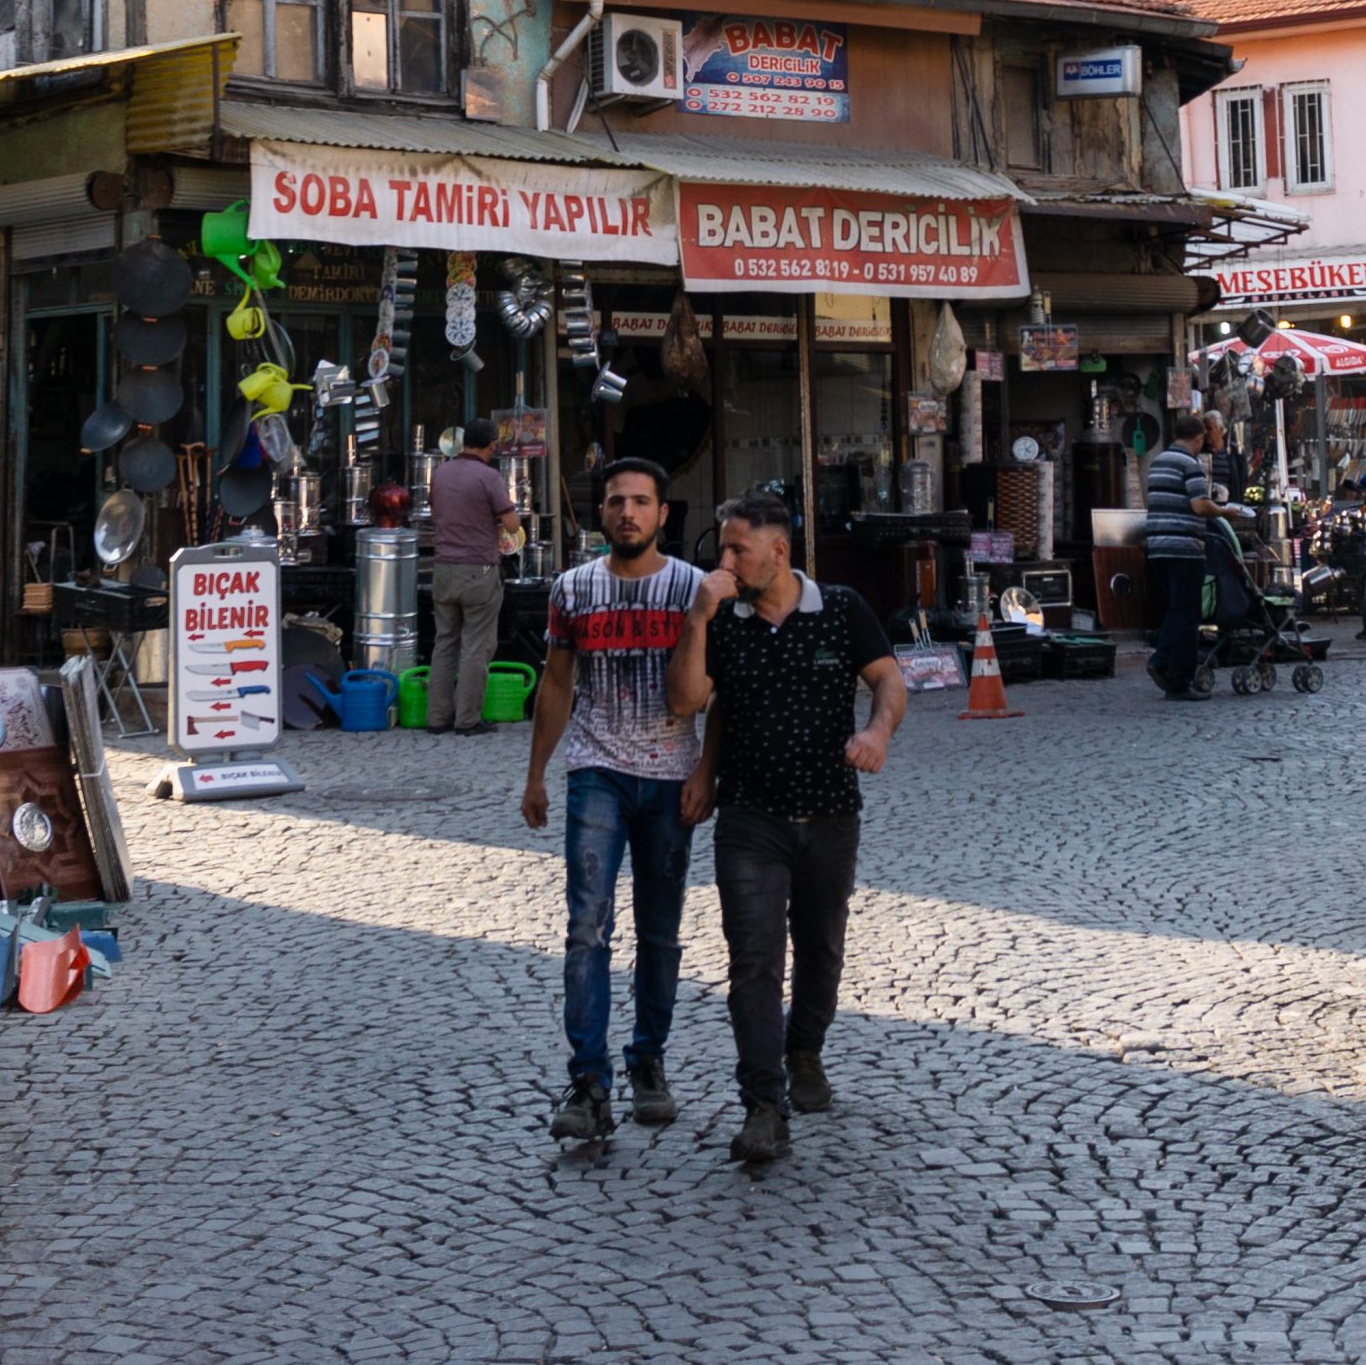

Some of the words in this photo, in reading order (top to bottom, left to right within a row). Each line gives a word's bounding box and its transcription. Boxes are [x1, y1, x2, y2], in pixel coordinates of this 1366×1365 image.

[724, 21, 844, 62] BABAT
[742, 73, 770, 84] 507
[708, 100, 742, 112] 272
[748, 103, 777, 114] 212
[783, 105, 804, 116] 28
[811, 107, 836, 118] 90
[709, 89, 743, 100] 532
[749, 91, 782, 103] 562
[788, 94, 810, 105] 82
[816, 96, 834, 107] 19
[273, 171, 378, 220] SOBA
[519, 189, 653, 237] YAPILIR
[697, 203, 825, 250] BABAT
[748, 259, 776, 277] 532
[780, 259, 811, 277] 562
[878, 263, 905, 281] 531
[909, 264, 935, 282] 957
[938, 265, 957, 283] 40
[960, 265, 978, 283] 89
[193, 571, 260, 600] BIÇAK
[185, 600, 269, 632] BİLENİR
